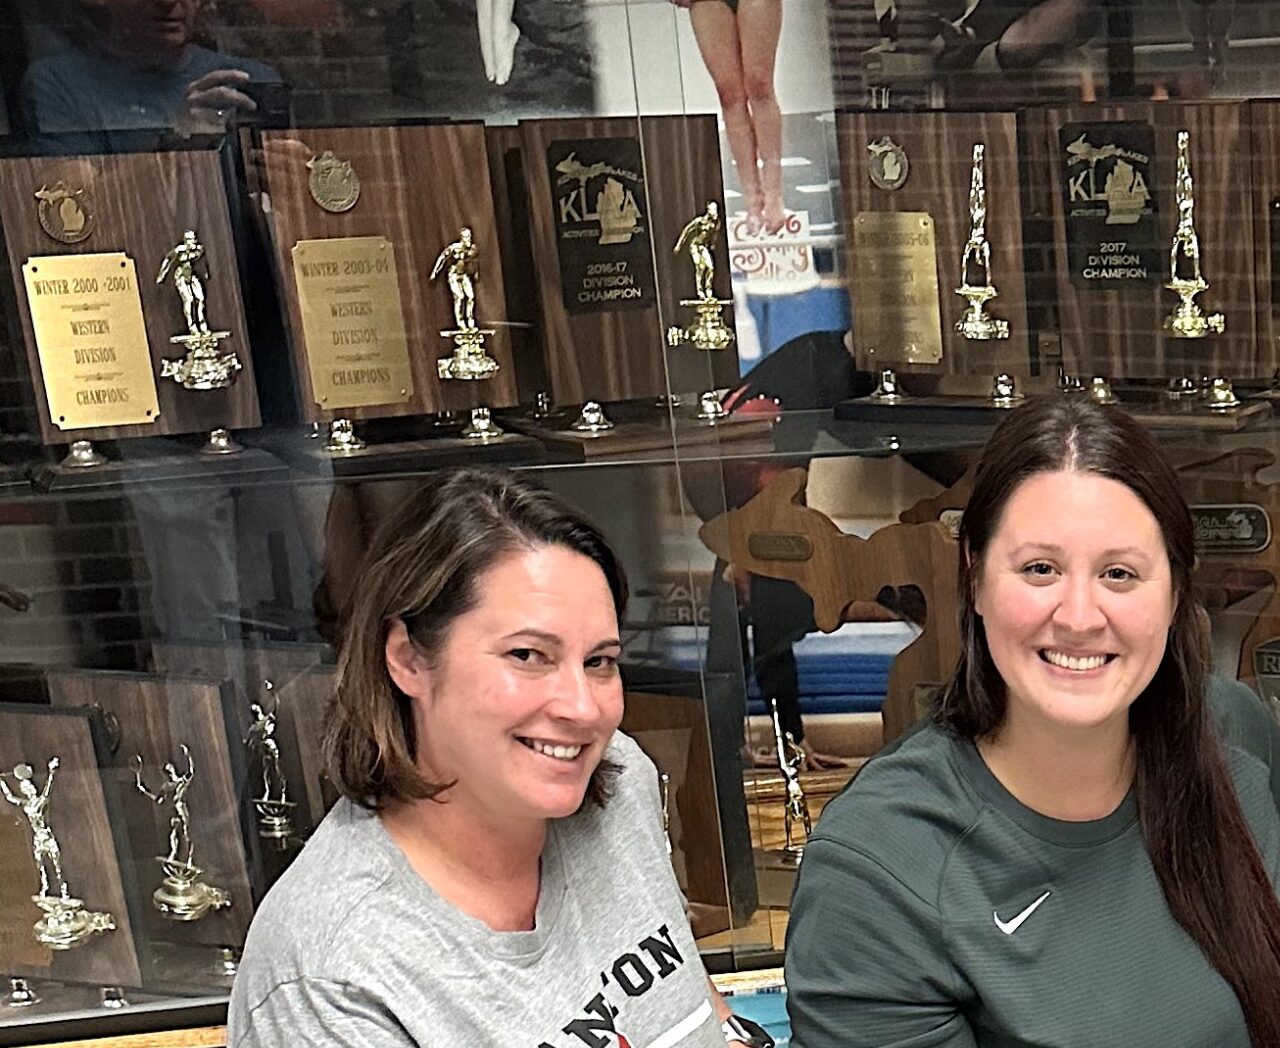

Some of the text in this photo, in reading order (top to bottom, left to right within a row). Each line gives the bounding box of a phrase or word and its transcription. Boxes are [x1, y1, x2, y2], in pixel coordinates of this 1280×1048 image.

[1100, 242, 1127, 253] 2017
[1088, 255, 1140, 266] DIVISION
[301, 261, 339, 277] WINTER
[587, 262, 627, 275] 2016-17
[1083, 268, 1147, 279] CHAMPION
[34, 280, 69, 295] WINTER
[73, 278, 98, 293] 2000
[583, 275, 634, 288] DIVISION
[578, 288, 642, 302] CHAMPION
[329, 302, 373, 317] WESTERN
[70, 320, 110, 335] WESTERN
[332, 328, 378, 345] DIVISION
[74, 347, 116, 364] DIVISION
[332, 368, 390, 385] CHAMPIONS
[76, 388, 129, 405] CHAMPIONS
